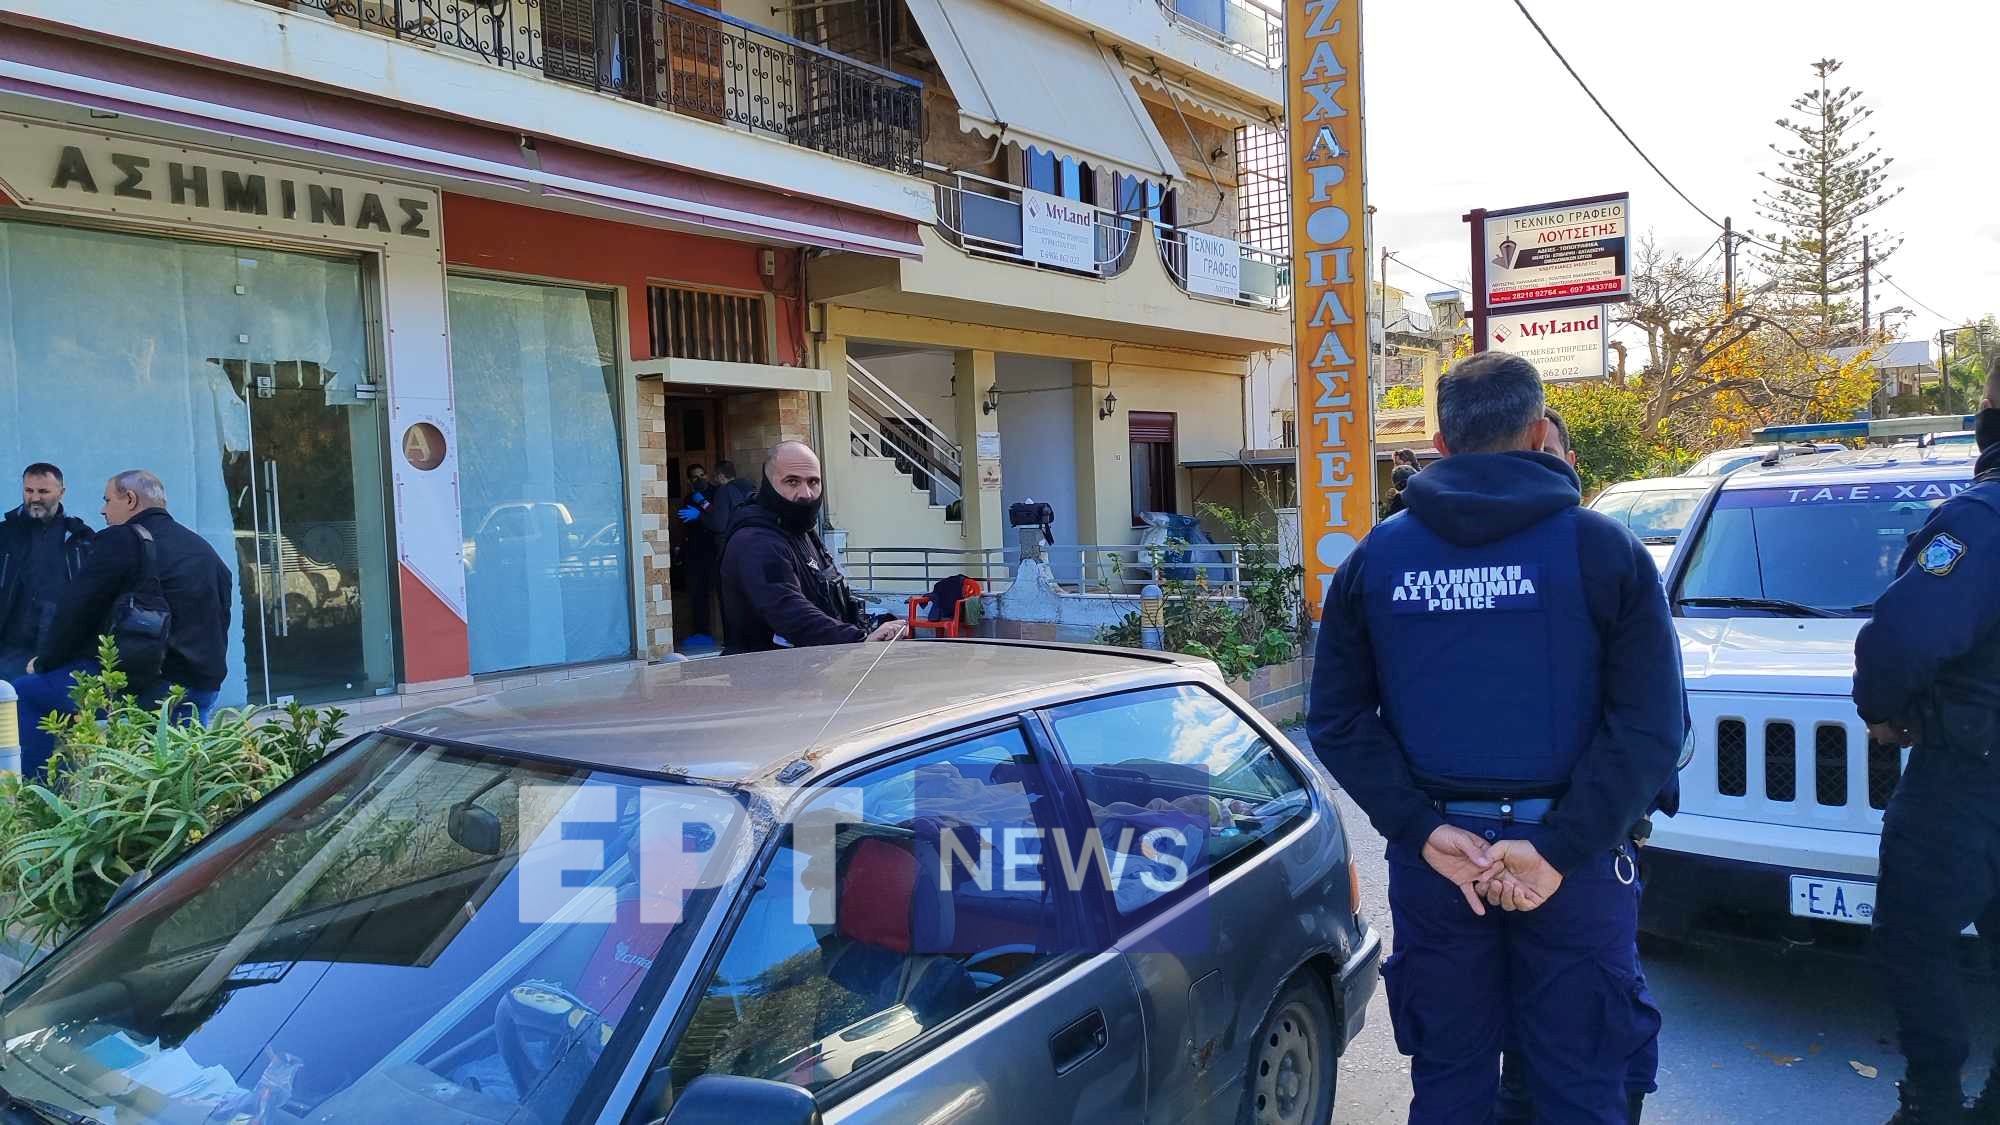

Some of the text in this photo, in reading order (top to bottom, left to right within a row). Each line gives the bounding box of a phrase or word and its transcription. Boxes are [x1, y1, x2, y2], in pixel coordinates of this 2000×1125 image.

[51, 145, 431, 238] ΑΣΗΜΙΝΑΣ
[1046, 202, 1090, 227] MyLand
[1514, 206, 1621, 230] ΤΕΧΝΙΚΟ ΓΡΑΦΕΙΟ
[1538, 223, 1617, 244] ΛΟΥΤΣΕΤΗΣ
[1190, 236, 1225, 257] ΤΕΧΝΙΚΟ
[1203, 258, 1238, 279] ΓΡΑΦΕΙΟ
[1301, 0, 1359, 608] ΖΑΧΑΡΟΠΛΑΣΤΕΙΟ
[1520, 315, 1600, 340] MyLand
[1403, 565, 1522, 587] ΕΛΛΗΝΙΚΗ
[1392, 579, 1536, 601] ΑΣΤΥΝΟΜΙΑ
[1428, 596, 1496, 612] POLICE
